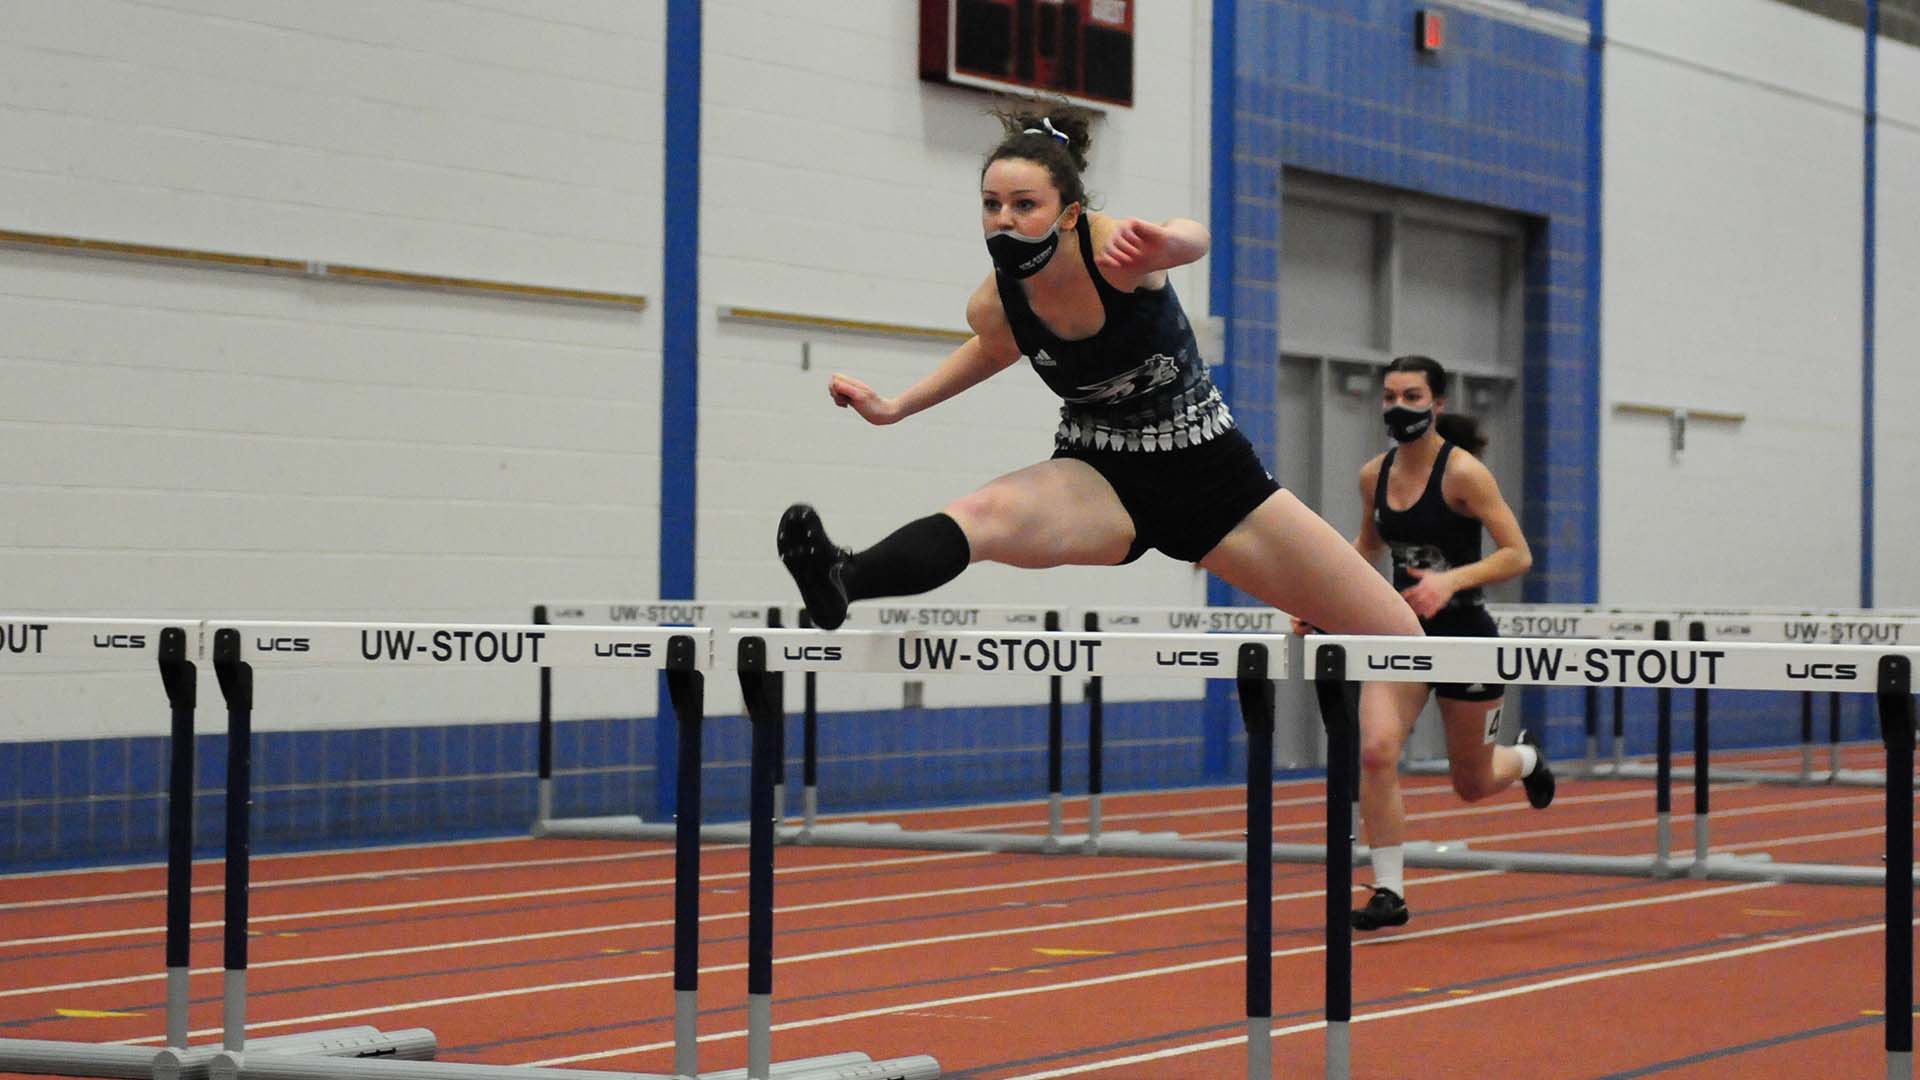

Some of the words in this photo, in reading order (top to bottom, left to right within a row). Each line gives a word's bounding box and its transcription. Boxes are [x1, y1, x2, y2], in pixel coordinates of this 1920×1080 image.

[609, 605, 705, 623] UW-STOUT
[879, 608, 980, 626] UW-STOUT
[1168, 611, 1275, 631] UW-STOUT
[0, 623, 48, 654] UT
[93, 634, 146, 649] UCS
[1783, 622, 1904, 642] UW-STOUT
[257, 637, 311, 652] UCS
[361, 629, 546, 664] UW-STOUT
[594, 642, 653, 658] UCS
[783, 646, 843, 661] UCS
[898, 637, 1102, 673] UW-STOUT
[1156, 651, 1220, 667] UCS
[1367, 654, 1433, 671] UCS
[1496, 646, 1725, 685] UW-STOUT
[1786, 663, 1858, 680] UCS
